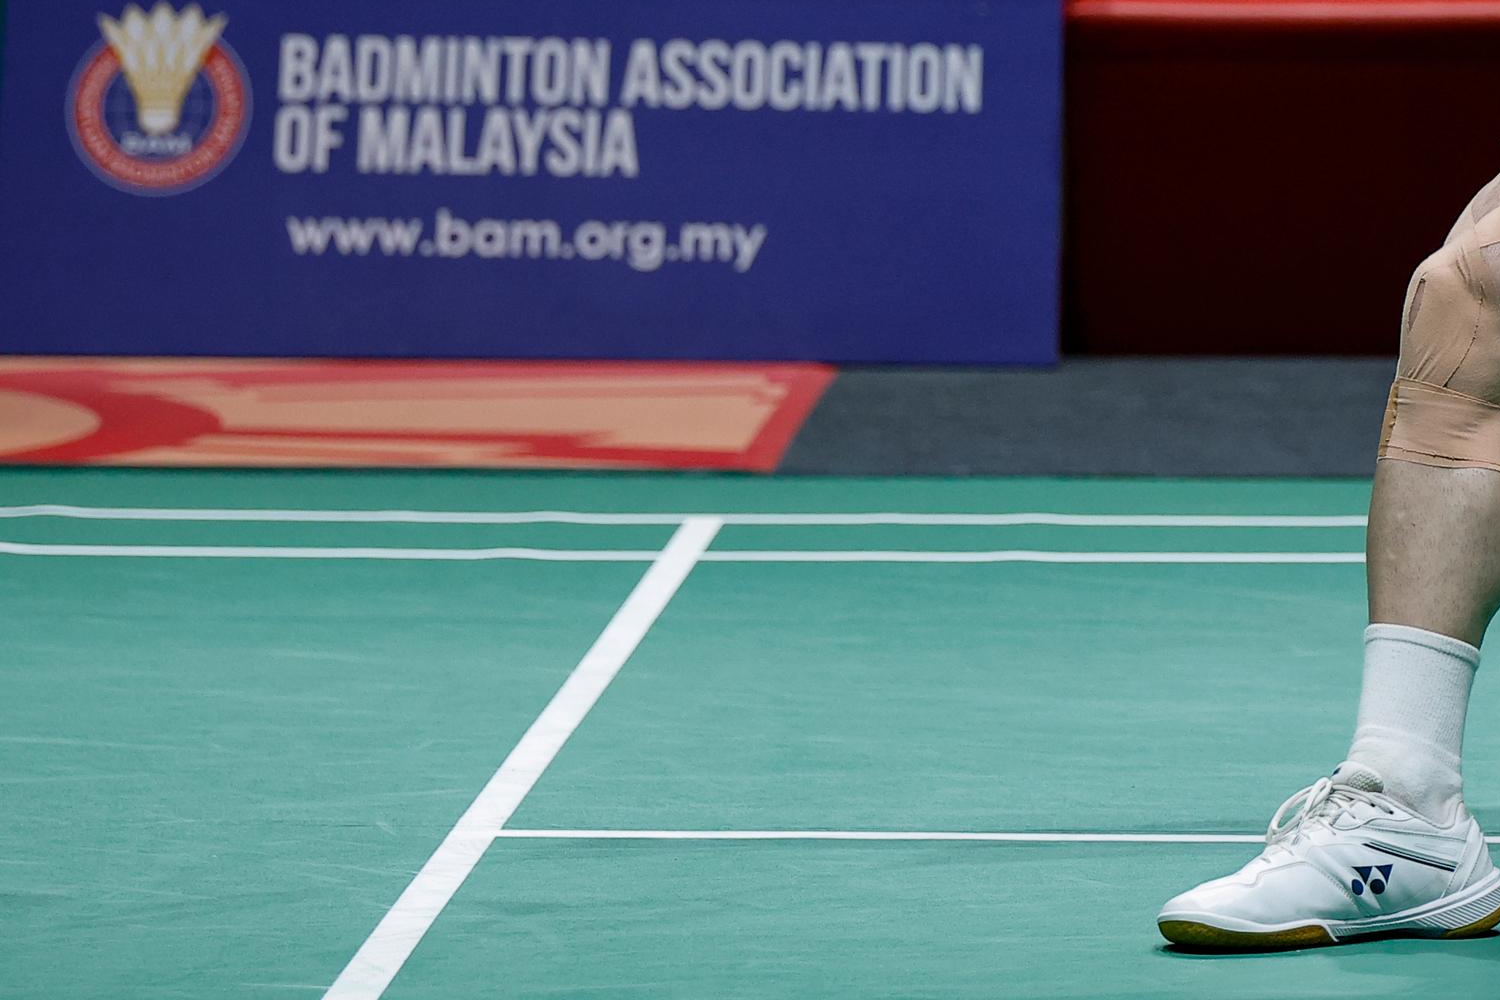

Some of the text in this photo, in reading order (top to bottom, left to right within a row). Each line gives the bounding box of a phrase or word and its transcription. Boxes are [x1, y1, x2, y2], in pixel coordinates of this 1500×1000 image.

[279, 32, 985, 114] BADMINTON ASSOCIATION
[273, 104, 640, 178] OF MALAYSIA
[286, 207, 767, 273] www.bam.org.my
